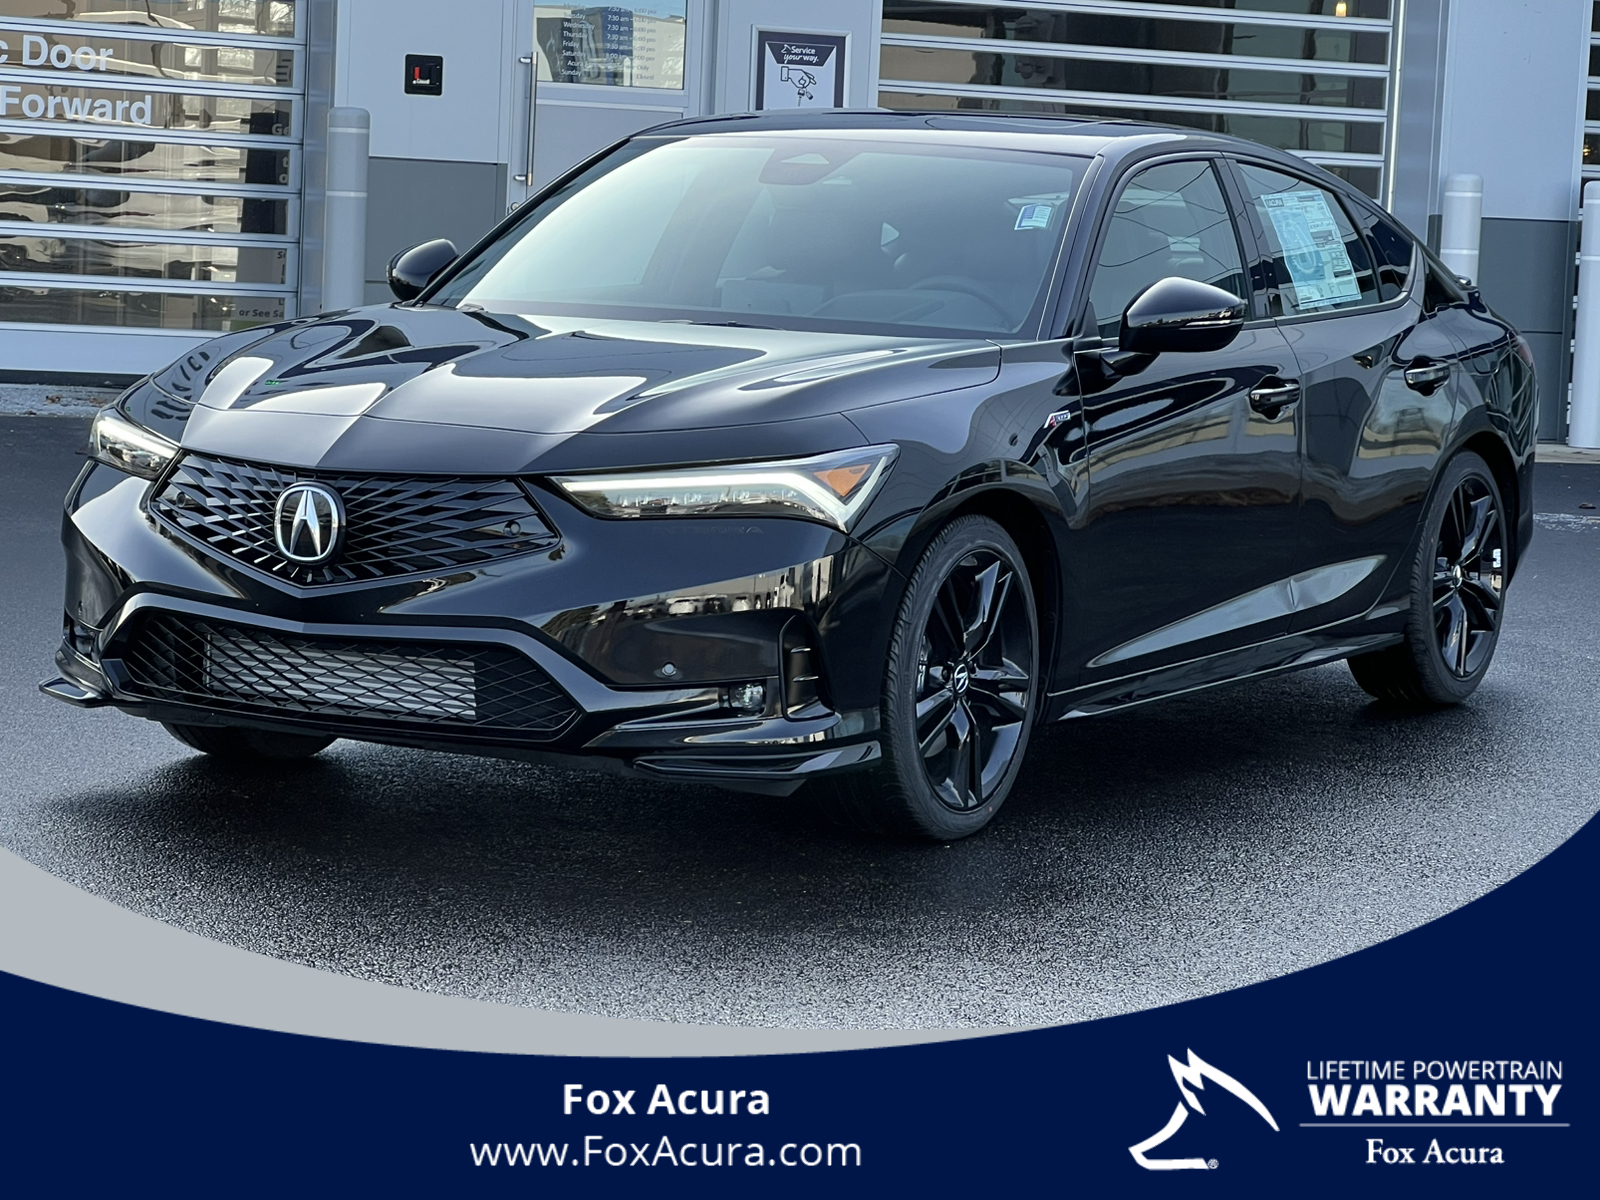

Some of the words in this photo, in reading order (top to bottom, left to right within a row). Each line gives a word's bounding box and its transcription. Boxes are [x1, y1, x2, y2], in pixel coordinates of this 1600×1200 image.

[562, 40, 580, 49] Friday
[22, 34, 114, 71] Door
[562, 50, 586, 58] Saturday
[791, 46, 816, 55] Service
[783, 54, 802, 64] your
[561, 69, 581, 77] Sunday
[0, 85, 153, 125] Forward
[239, 309, 250, 317] or
[252, 308, 270, 318] See
